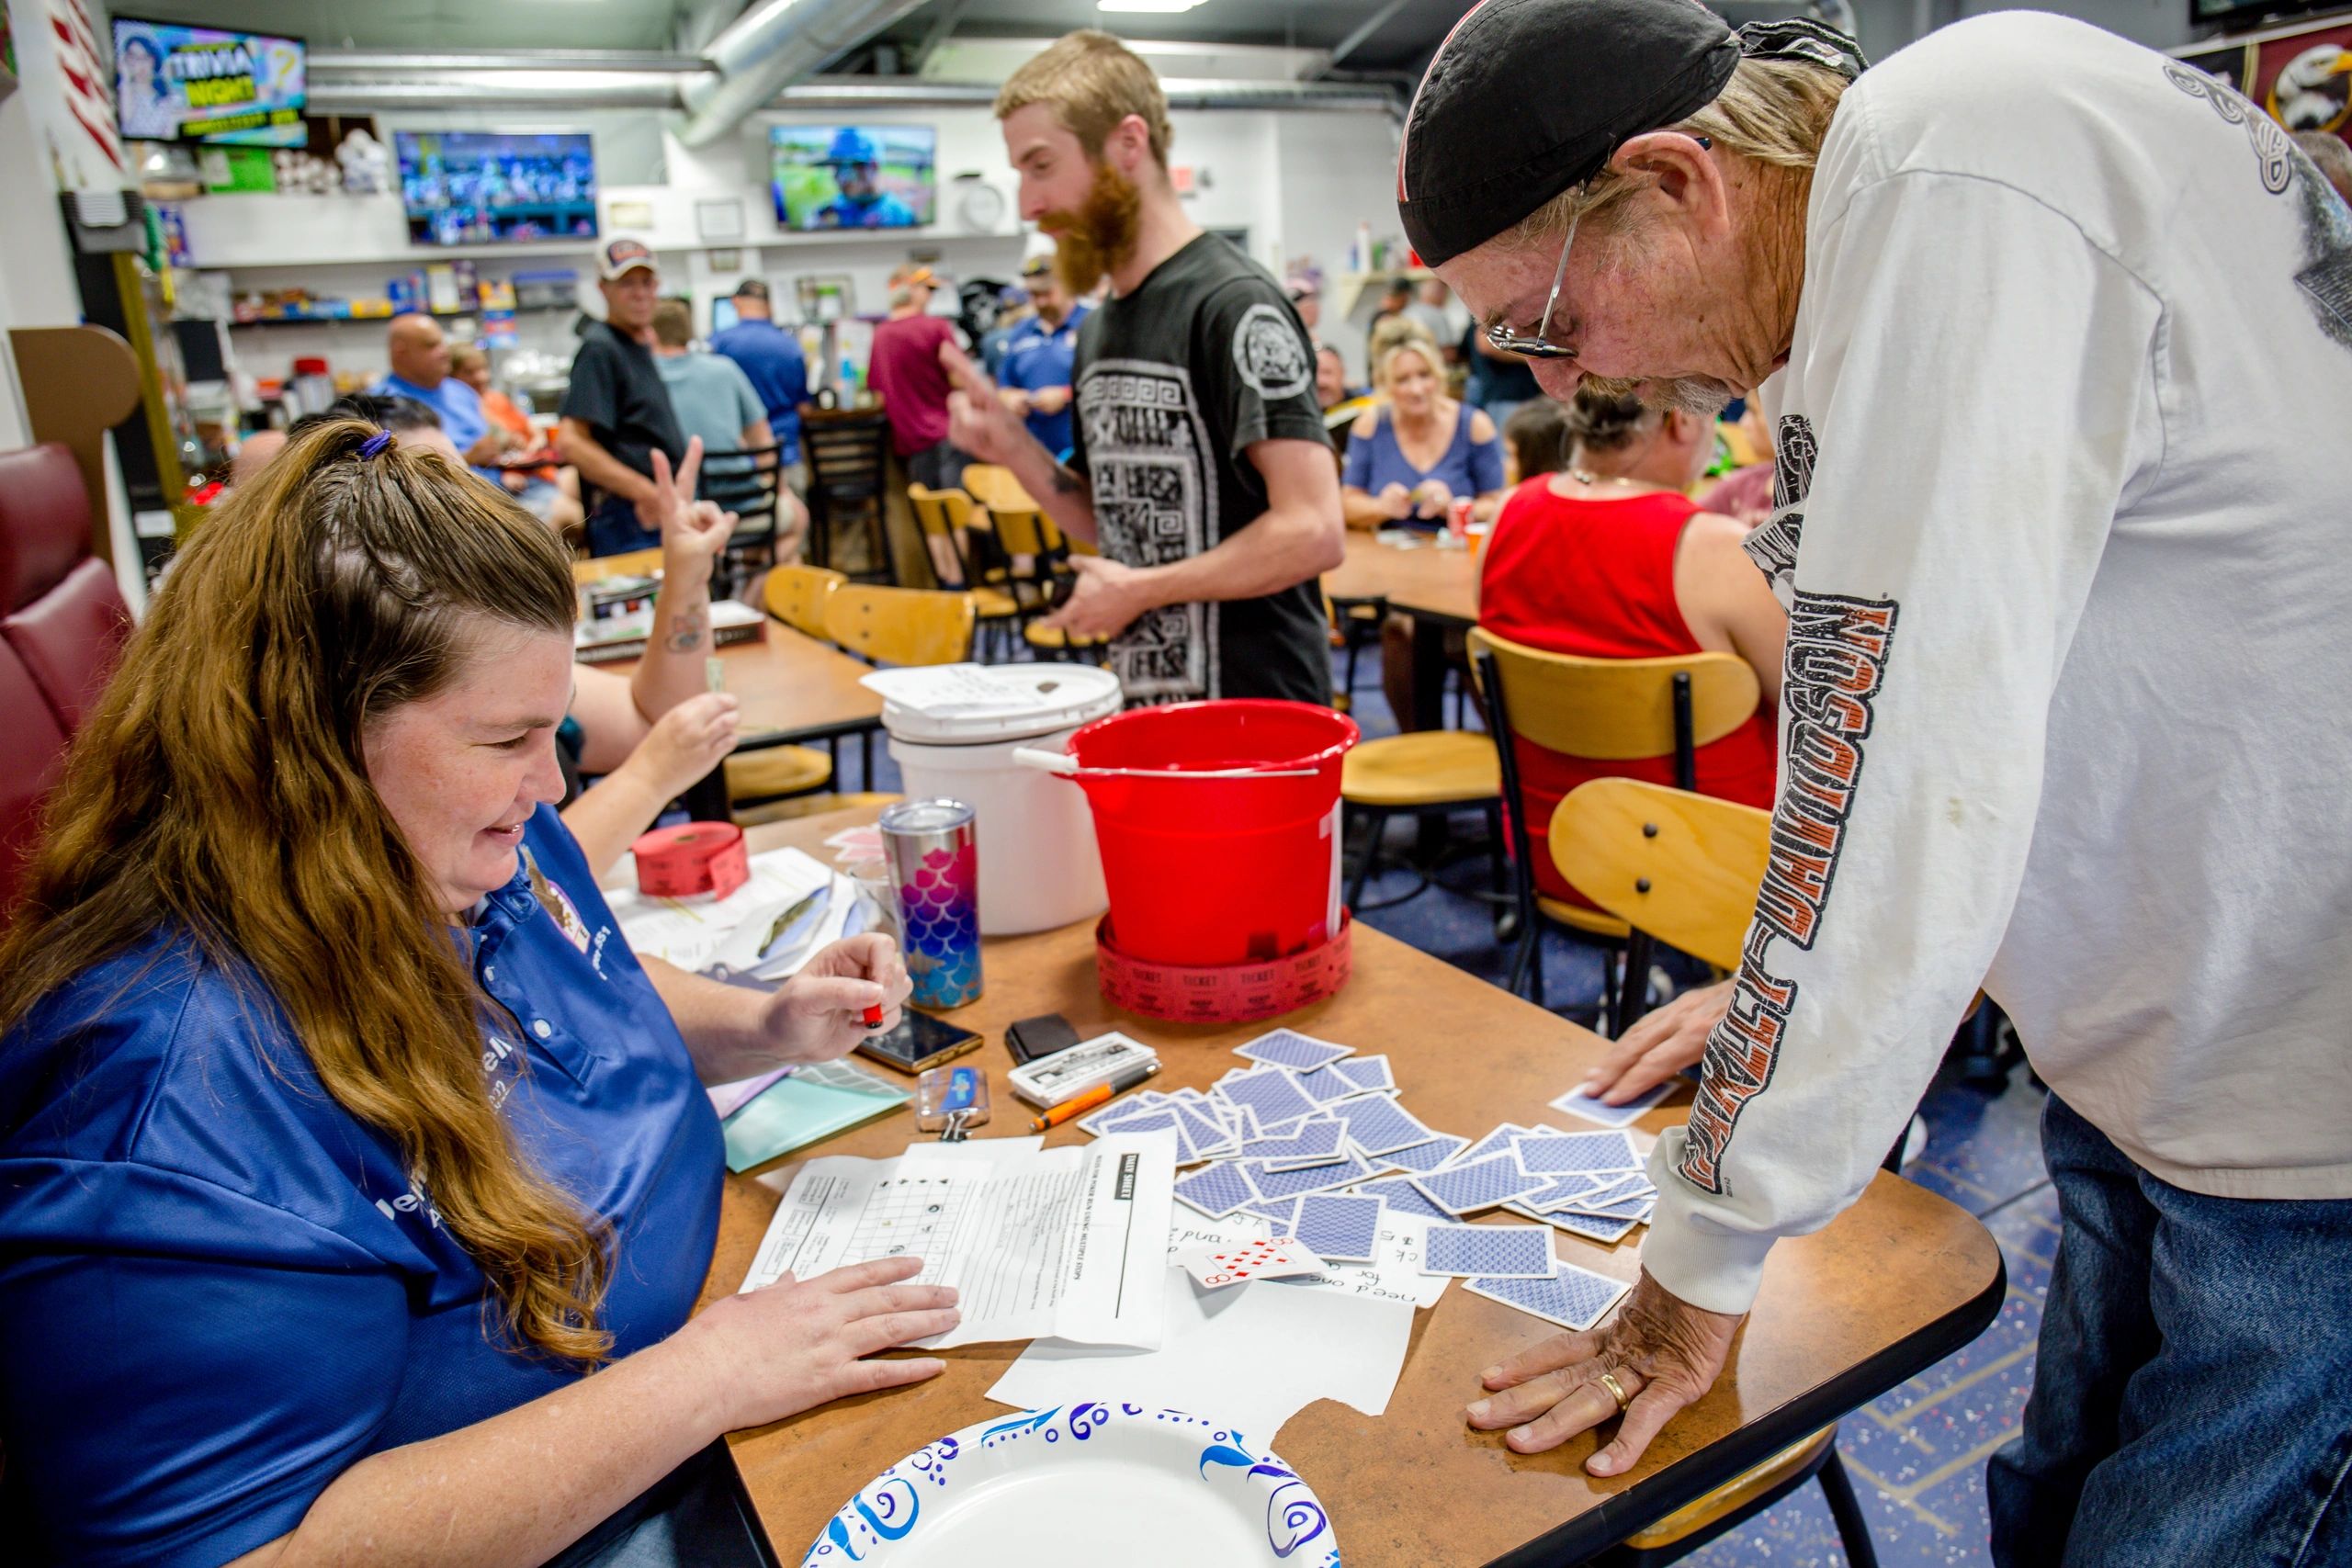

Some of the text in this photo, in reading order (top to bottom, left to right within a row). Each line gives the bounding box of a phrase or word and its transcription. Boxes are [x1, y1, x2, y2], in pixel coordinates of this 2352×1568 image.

[168, 46, 254, 81] TRIVIA
[187, 75, 256, 107] NIGHT
[1133, 968, 1162, 983] TICKET
[1182, 976, 1217, 987] TICKET
[1241, 969, 1275, 982] TICKET
[1121, 1155, 1137, 1198] TALLY SHEET
[1077, 1234, 1088, 1259] MULTIPLE
[1073, 1262, 1083, 1280] STOPS
[1204, 1273, 1231, 1284] 8
[1355, 1269, 1382, 1287] for
[1308, 1274, 1416, 1303] need one
